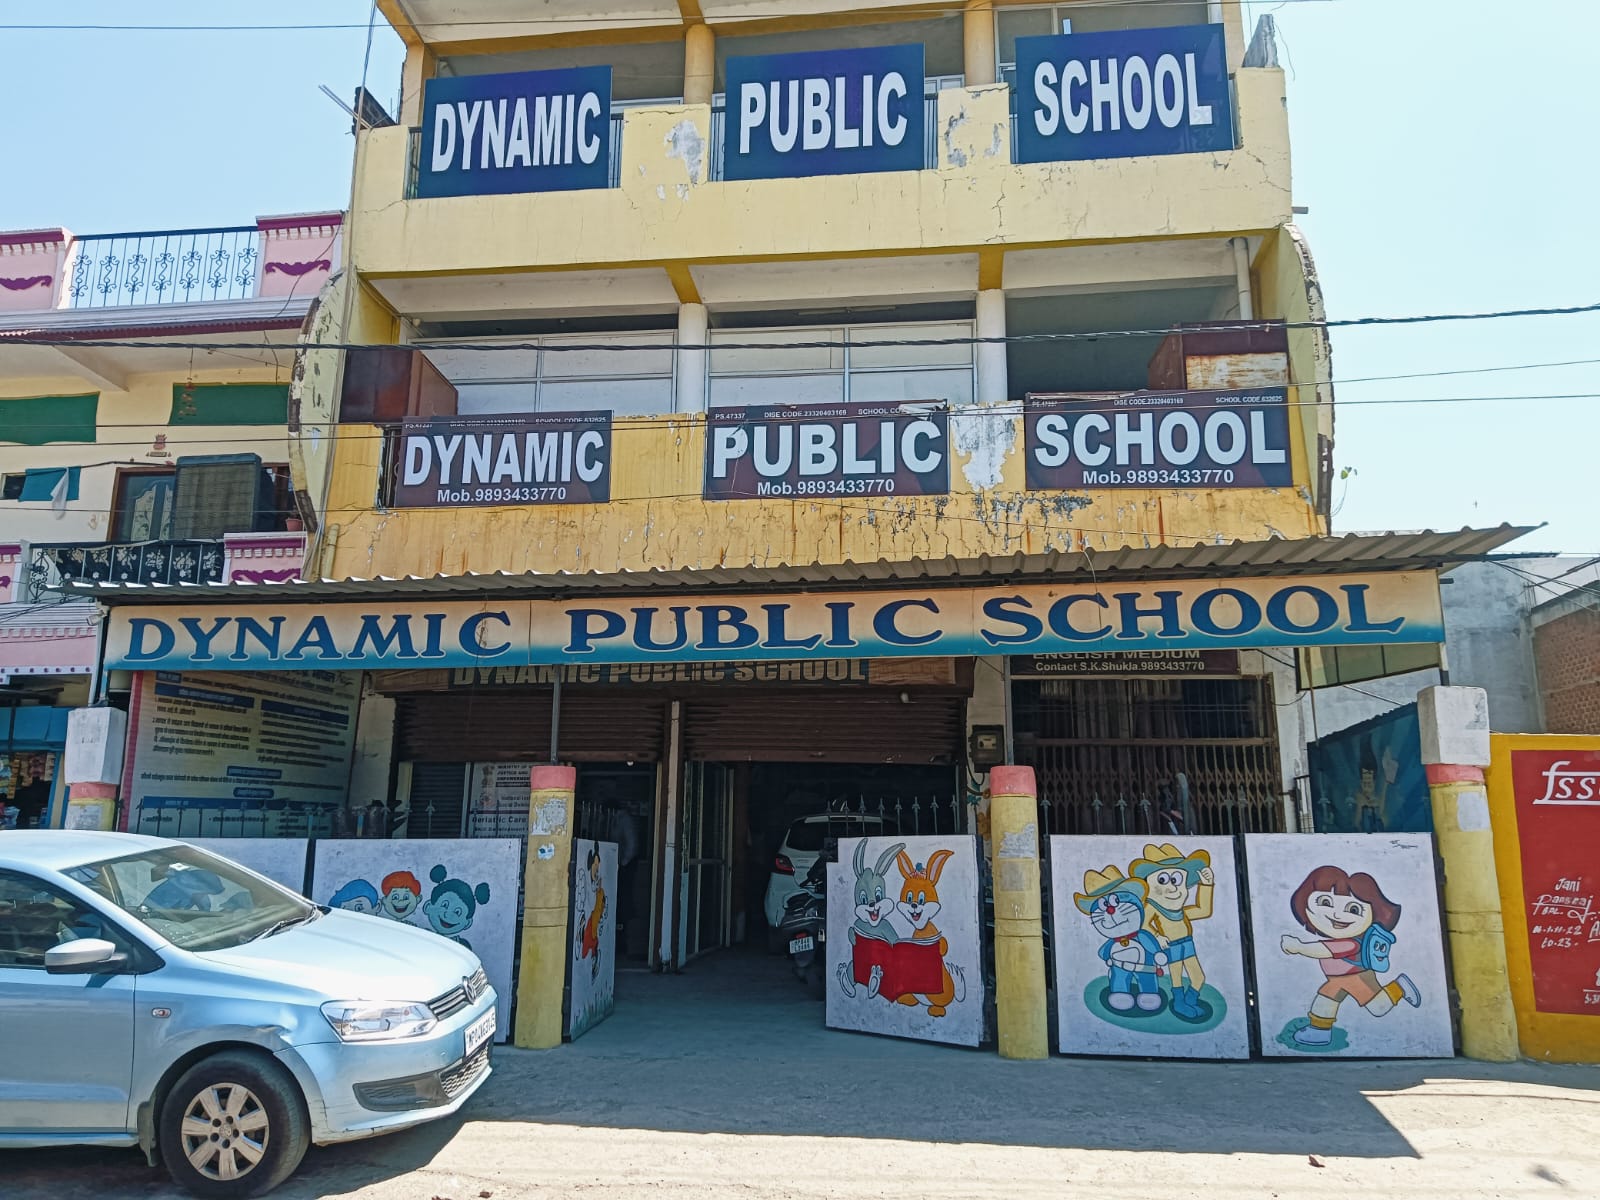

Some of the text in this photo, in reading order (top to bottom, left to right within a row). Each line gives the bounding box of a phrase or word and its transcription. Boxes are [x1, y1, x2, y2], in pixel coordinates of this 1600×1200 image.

[431, 53, 1213, 172] DYNAMIC PUBLIC SCHOOL
[1215, 396, 1241, 404] SCHOOL
[764, 411, 780, 419] DISE
[858, 407, 888, 415] SCHOOL
[1034, 410, 1286, 467] SCHOOL
[712, 420, 942, 478] PUBLIC
[403, 430, 604, 486] DYNAMIC
[1082, 469, 1234, 485] Mob.9893433770
[437, 487, 566, 503] Mob.9893433770
[757, 479, 895, 496] Mob.9893433770
[122, 584, 1406, 662] DYNAMIC PUBLIC SCHOOL
[1122, 650, 1201, 659] MEDIUM
[733, 659, 866, 682] SCHOOL
[1035, 662, 1078, 671] Contact
